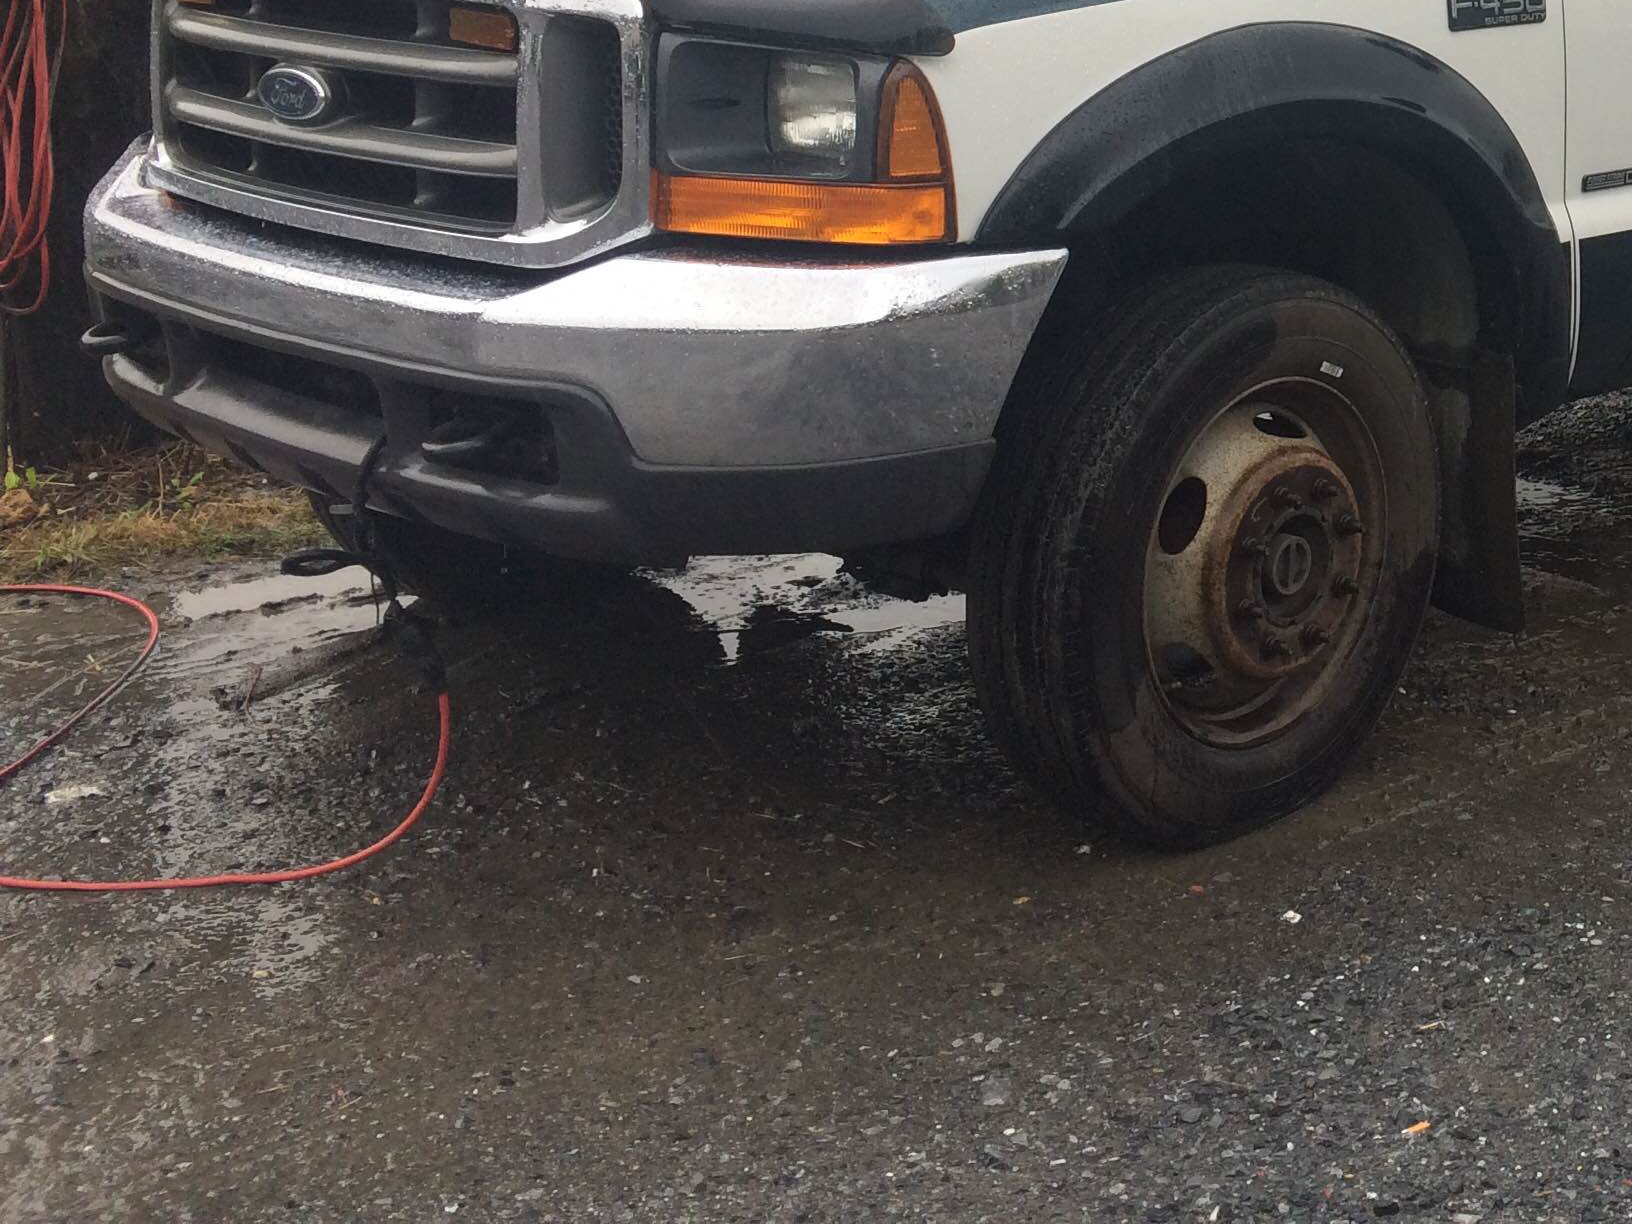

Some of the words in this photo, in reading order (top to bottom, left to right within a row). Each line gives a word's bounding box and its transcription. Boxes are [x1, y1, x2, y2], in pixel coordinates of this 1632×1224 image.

[1485, 15, 1518, 25] SUPER
[1520, 12, 1546, 22] DUTY
[270, 77, 307, 109] Ford
